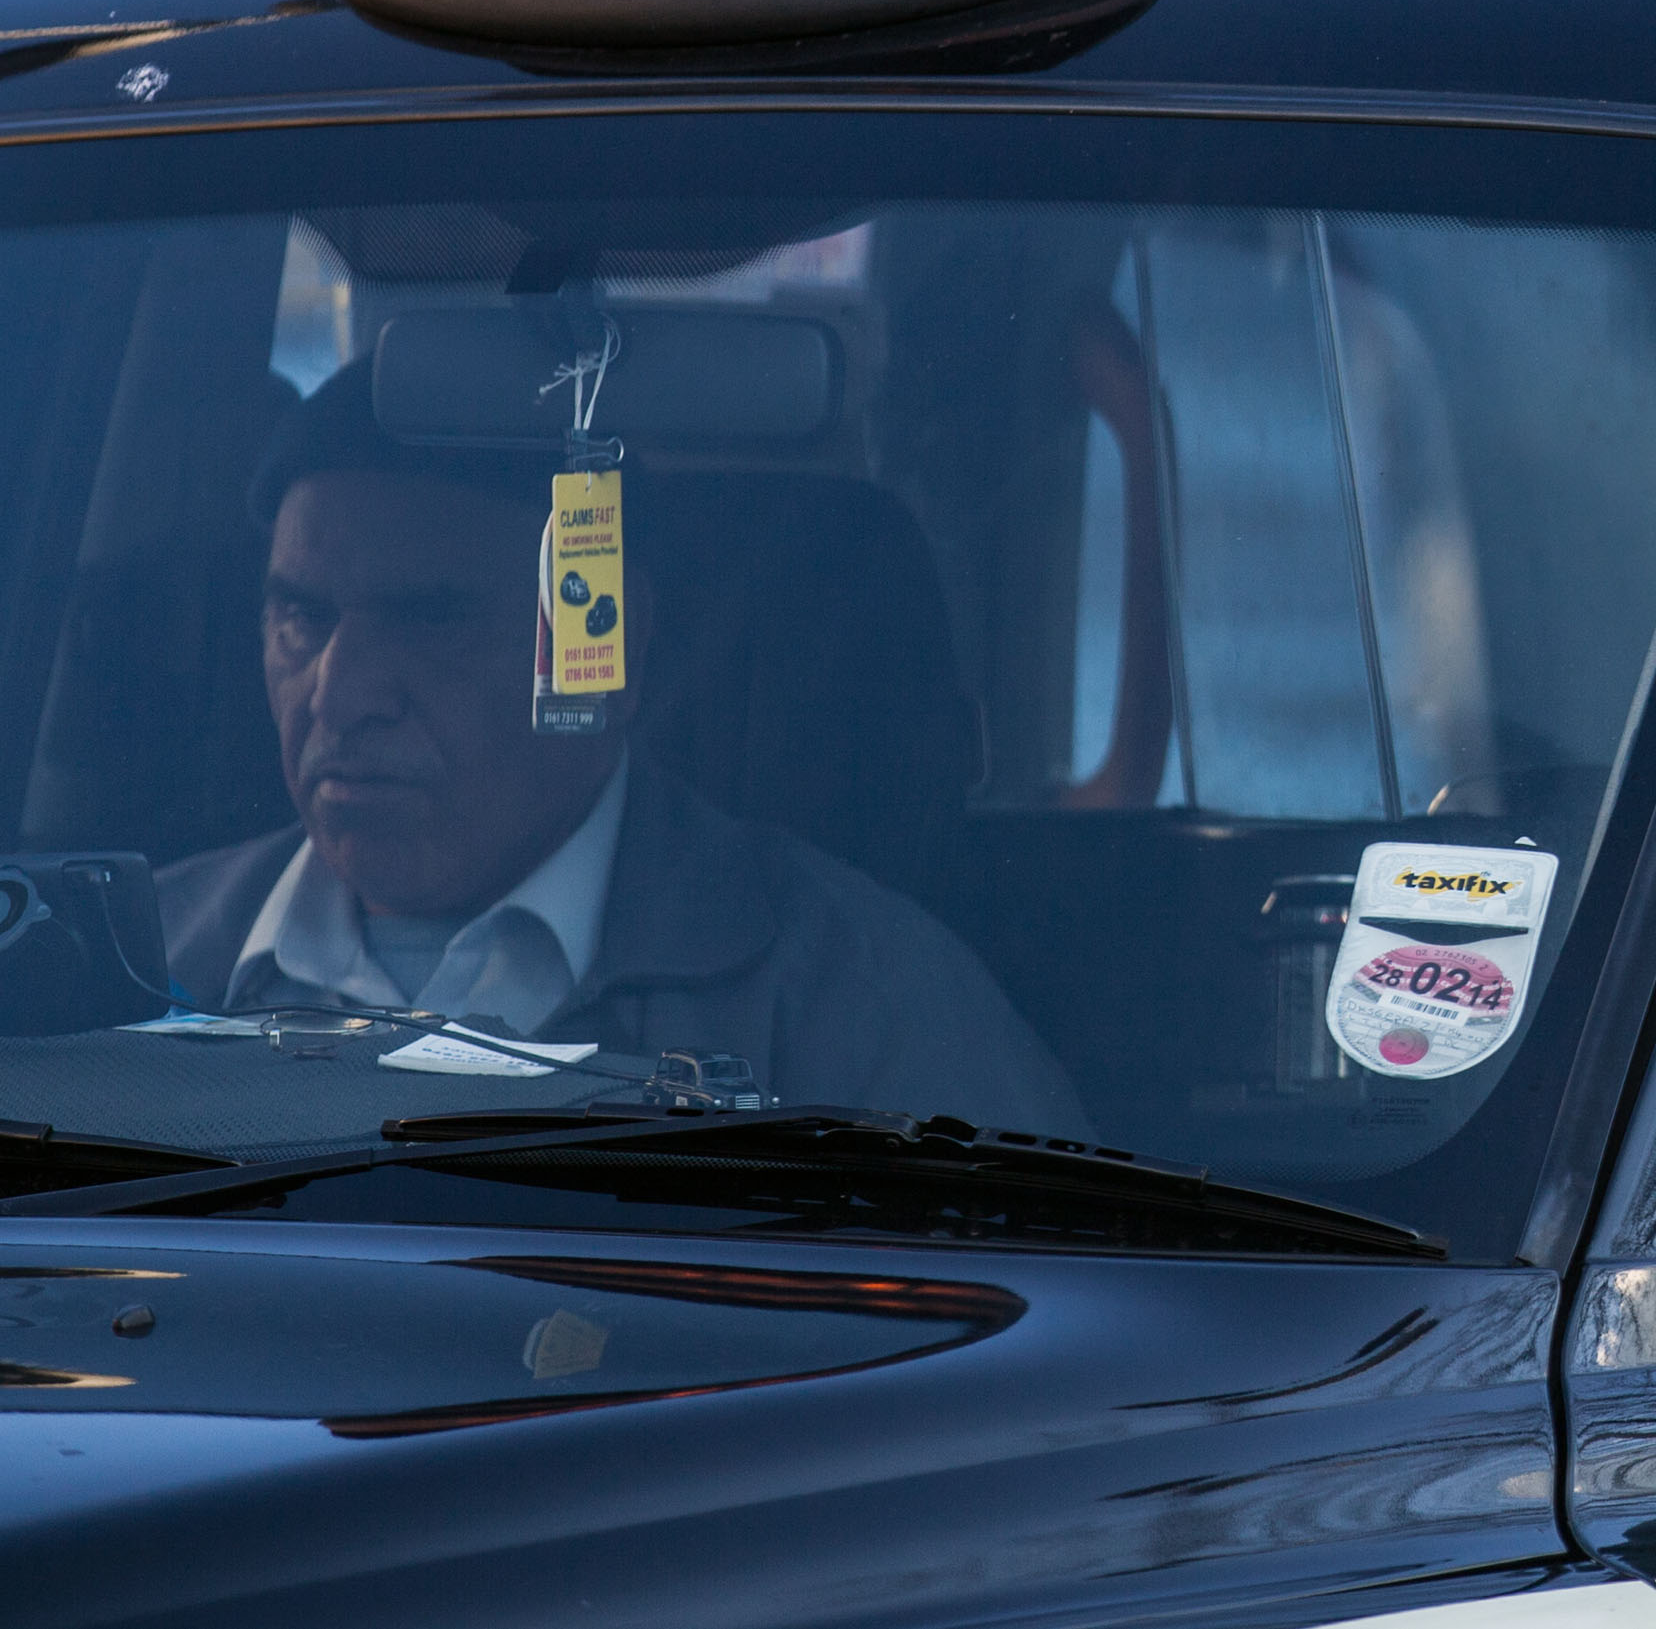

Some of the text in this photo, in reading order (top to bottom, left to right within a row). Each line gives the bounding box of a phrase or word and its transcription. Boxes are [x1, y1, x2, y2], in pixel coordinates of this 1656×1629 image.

[560, 508, 593, 528] CLAIMS
[1401, 872, 1510, 894] taxifix
[1368, 962, 1503, 1010] 28 02 14
